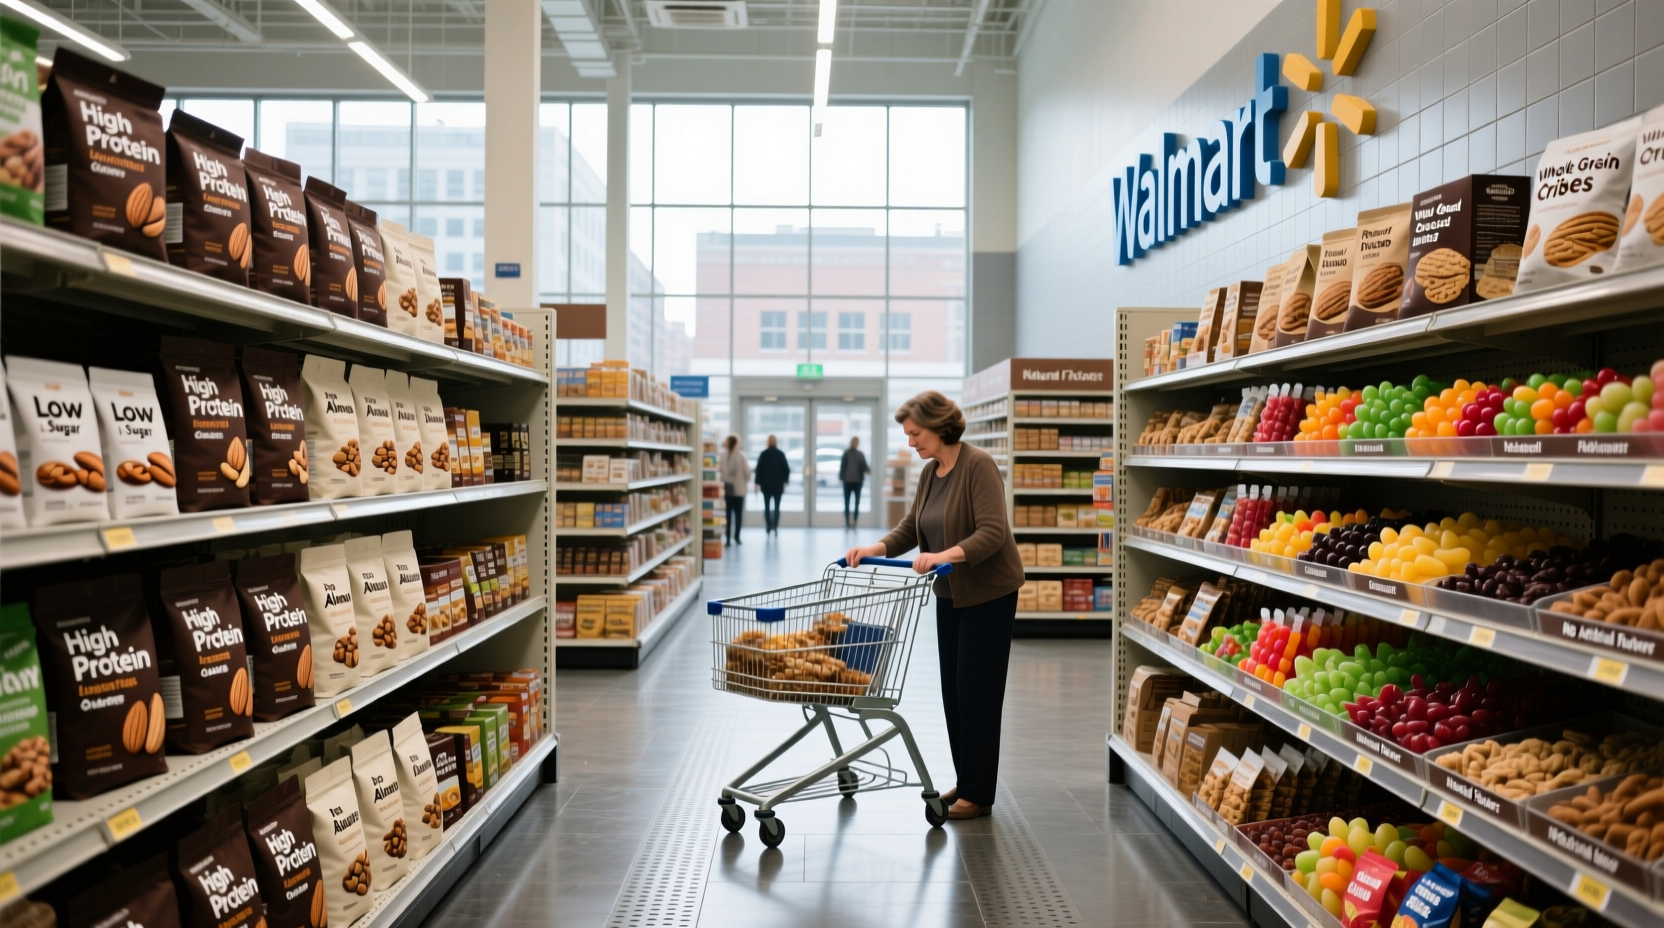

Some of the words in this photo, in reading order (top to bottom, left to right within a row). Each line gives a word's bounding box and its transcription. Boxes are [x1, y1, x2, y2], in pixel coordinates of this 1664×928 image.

[80, 101, 132, 135] High
[85, 124, 161, 165] Protein
[193, 152, 228, 178] High
[1110, 53, 1289, 266] Walmart
[1578, 152, 1620, 171] Grain
[181, 374, 219, 397] High
[34, 396, 82, 419] Low
[111, 402, 153, 423] Low
[188, 395, 244, 418] Protein
[47, 420, 80, 437] Sugar
[125, 424, 153, 439] Sugar
[182, 606, 221, 632] High
[63, 625, 120, 656] High
[71, 646, 152, 682] Protein
[198, 864, 235, 896] High
